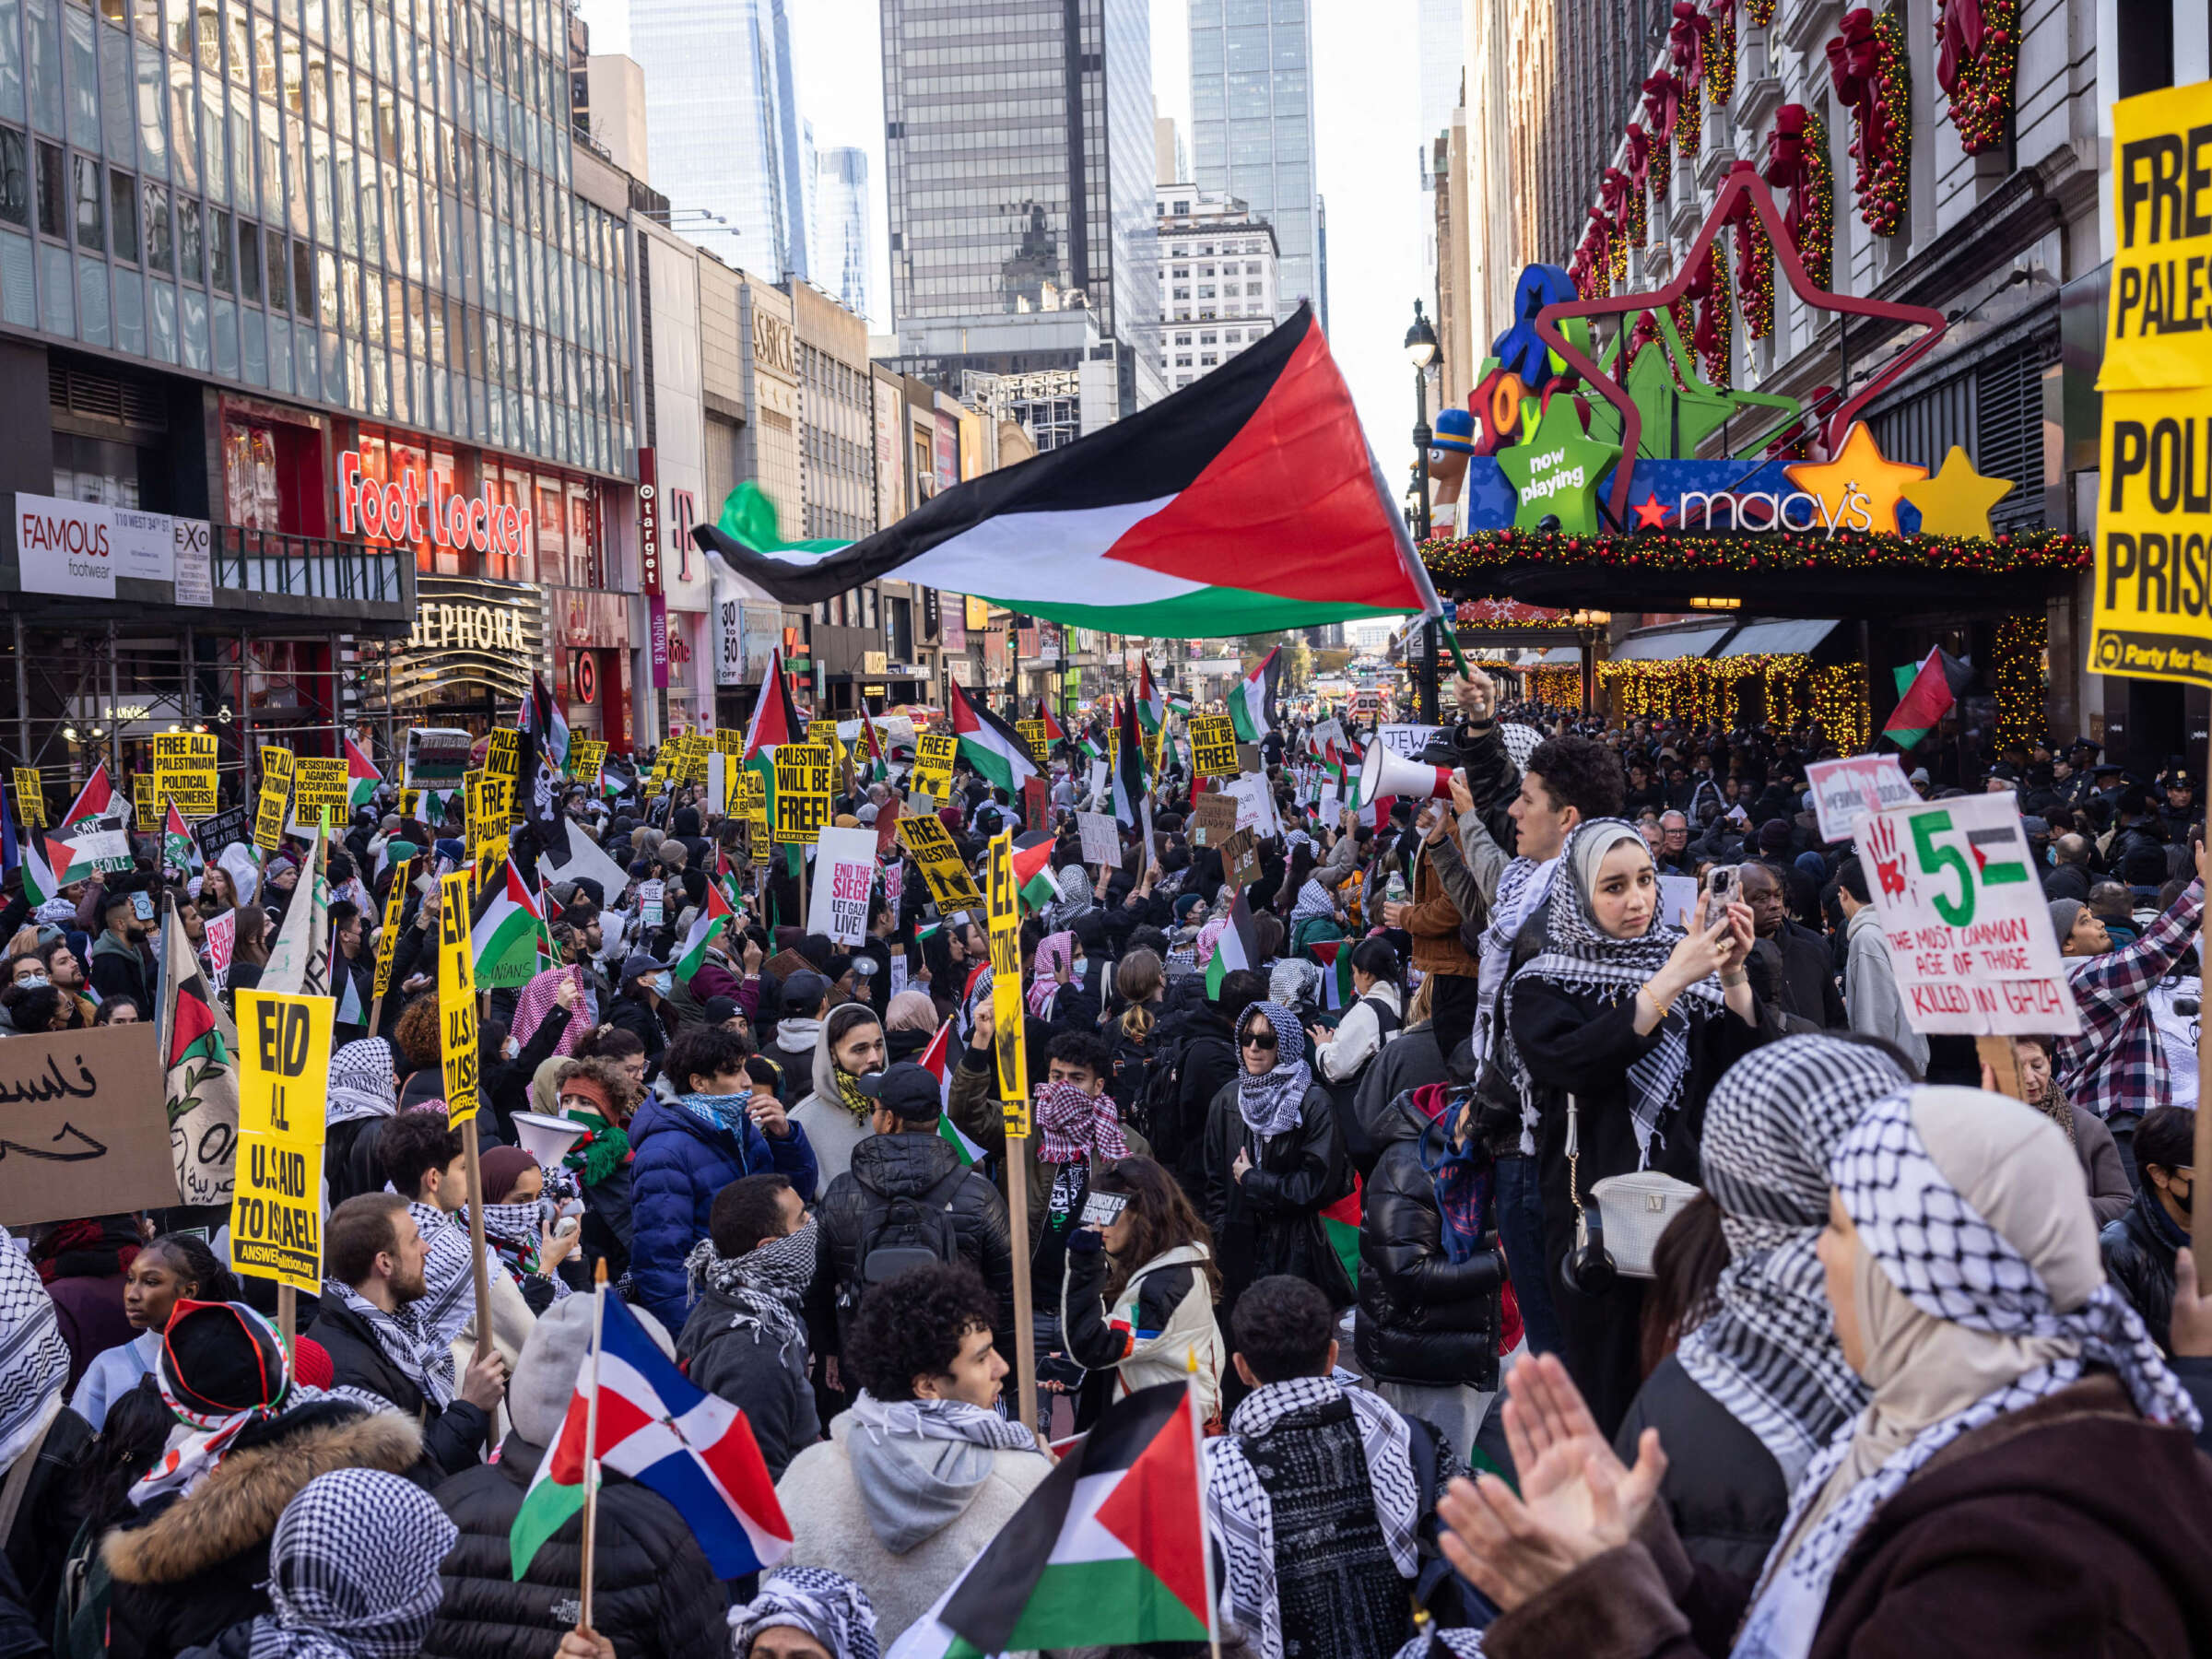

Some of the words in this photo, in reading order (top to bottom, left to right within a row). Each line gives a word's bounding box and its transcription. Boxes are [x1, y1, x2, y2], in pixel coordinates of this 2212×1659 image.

[1529, 447, 1565, 475] now
[1521, 465, 1585, 505] playing
[337, 451, 423, 544] Foot
[428, 469, 532, 558] Locker
[130, 514, 147, 529] WEST
[23, 513, 110, 557] FAMOUS
[175, 522, 208, 552] EXO
[643, 501, 656, 584] target
[69, 559, 111, 580] footwear
[722, 601, 735, 627] 30
[653, 615, 666, 653] Mobile
[725, 628, 736, 636] to
[724, 637, 737, 664] 50
[2124, 643, 2167, 671] Party
[2169, 647, 2191, 669] for
[1191, 717, 1232, 731] PALESTINE
[157, 736, 186, 755] FREE
[190, 736, 215, 754] ALL
[921, 736, 952, 756] FREE
[1193, 731, 1218, 747] WILL
[1220, 728, 1233, 744] BE
[156, 757, 215, 771] PALESTINIAN
[297, 759, 347, 771] RESISTANCE
[776, 747, 830, 767] PALESTINE
[915, 756, 953, 771] PALESTINE
[1194, 745, 1236, 771] FREE!
[162, 775, 208, 789] POLITICAL
[297, 782, 347, 793] OCCUPATION
[305, 771, 340, 782] AGAINST
[778, 768, 807, 792] WILL
[812, 769, 829, 792] BE
[299, 794, 307, 802] IS
[309, 794, 314, 803] A
[315, 794, 347, 804] HUMAN
[299, 804, 346, 822] RIGT!
[778, 795, 829, 830] FREE!
[73, 818, 104, 838] SAVE
[905, 815, 946, 846] FREE
[911, 843, 961, 865] PALESTINE
[834, 863, 853, 878] END
[855, 865, 872, 880] THE
[1908, 810, 1975, 927] 5
[832, 877, 870, 901] SIEGE
[886, 880, 901, 899] SIE
[832, 900, 847, 913] LET
[848, 901, 866, 916] GAZA
[206, 921, 225, 944] END
[834, 913, 862, 935] LIVE!
[1886, 930, 1913, 953] THE
[1917, 926, 1956, 950] MOST
[1960, 918, 2030, 948] COMMON
[1915, 953, 1947, 977] AGE
[1953, 951, 1973, 975] OF
[1982, 947, 2032, 971] THOSE
[1911, 984, 1970, 1017] KILLED
[1972, 986, 1998, 1014] IN
[2003, 979, 2065, 1016] GAZA
[278, 1150, 306, 1198] AID
[238, 1196, 265, 1239] TO
[267, 1200, 318, 1253] ISRAEL!
